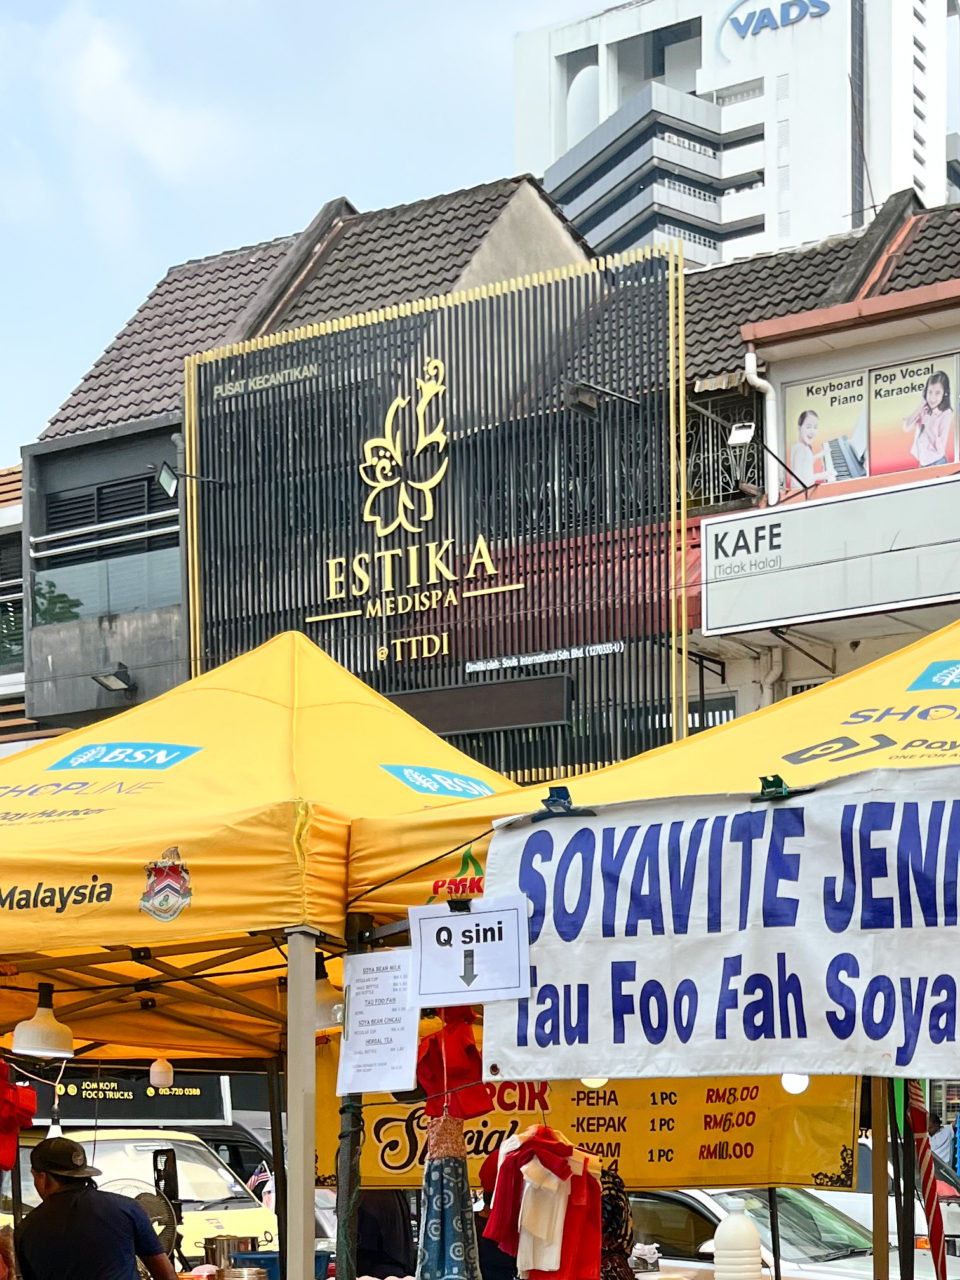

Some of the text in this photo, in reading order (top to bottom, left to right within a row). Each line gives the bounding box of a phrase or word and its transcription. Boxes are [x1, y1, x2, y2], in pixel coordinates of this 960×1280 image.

[730, 0, 831, 39] VADS
[213, 363, 318, 400] PUSAT KECANTIKAN
[873, 362, 935, 386] Pop Vocal
[806, 375, 864, 398] Keyboard
[874, 380, 924, 402] Karaoke
[829, 390, 864, 408] Piano
[714, 522, 782, 560] KAFE
[326, 533, 498, 601] ESTIKA
[366, 587, 459, 619] MEDISPA
[391, 632, 450, 662] TTDI
[99, 748, 181, 765] BSN
[432, 773, 493, 797] BSN
[517, 803, 805, 945] SOYAVITE
[0, 874, 114, 914] Malaysia
[435, 920, 503, 948] Q sini
[612, 961, 700, 1046] Foo
[716, 952, 808, 1042] Fah
[826, 951, 957, 1068] Soya
[81, 1081, 118, 1090] JOM KOPI
[106, 1090, 133, 1099] TRUCKS
[571, 1085, 760, 1106] -PEHA 1 PC RM8.00
[571, 1111, 756, 1132] -KEPAK 1 PC RM6.00
[647, 1149, 654, 1162] 1
[657, 1149, 674, 1162] PC
[698, 1140, 755, 1161] RM10.00
